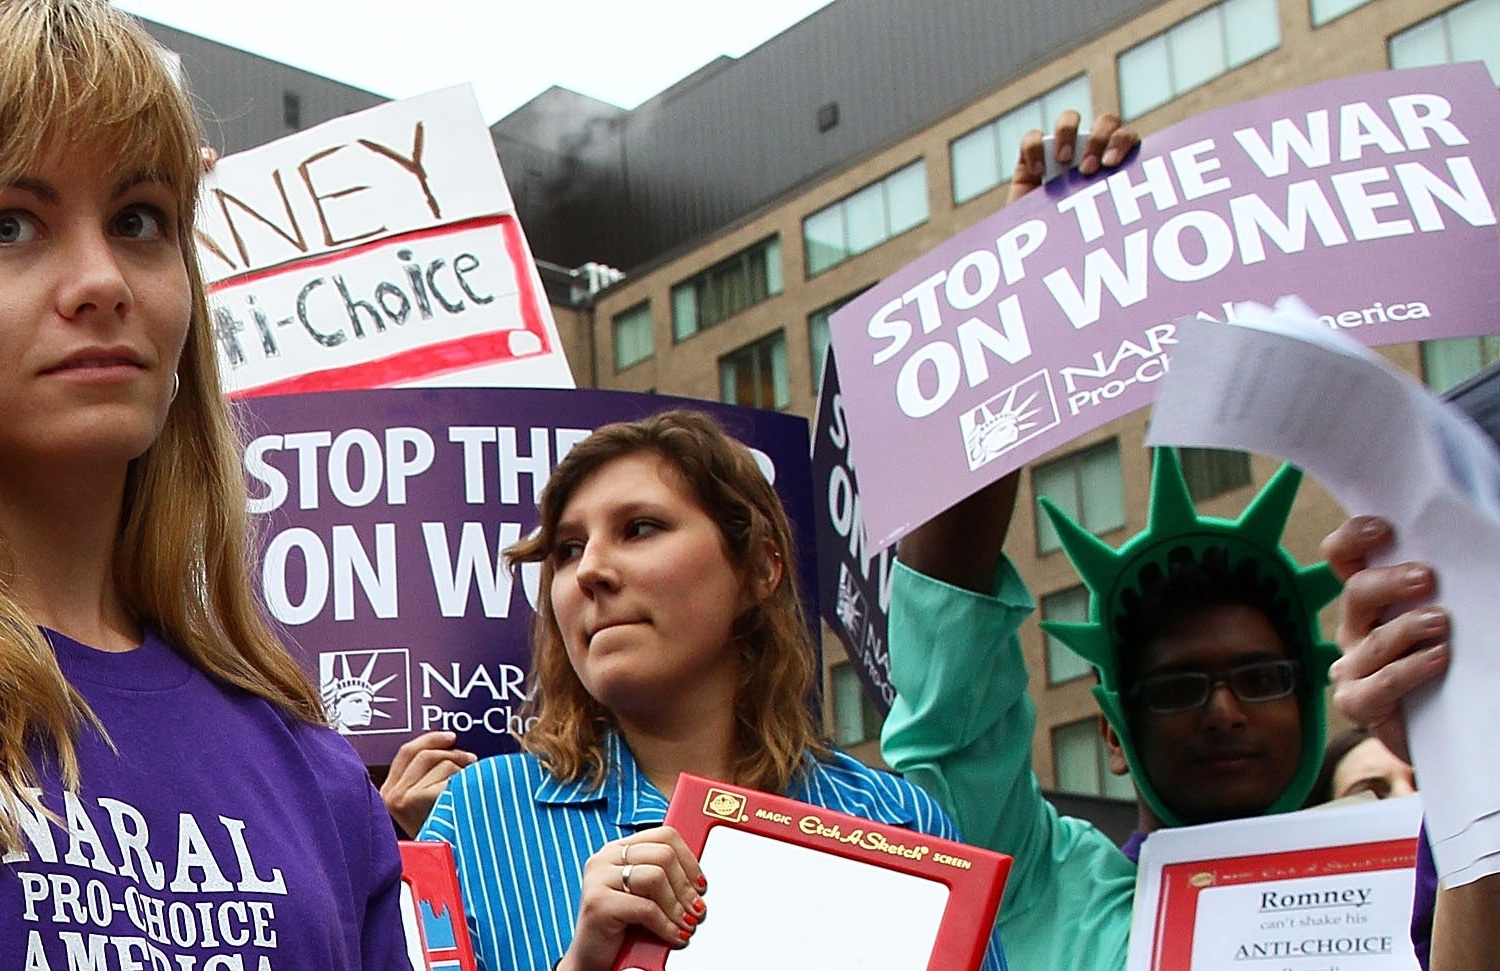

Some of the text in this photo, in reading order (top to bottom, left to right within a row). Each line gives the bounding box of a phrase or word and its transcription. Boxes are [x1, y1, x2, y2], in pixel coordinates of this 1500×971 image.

[865, 93, 1470, 365] STOP THE WAR
[895, 294, 1033, 418] ON
[1042, 156, 1497, 330] WOMEN
[243, 427, 435, 515] STOP
[262, 522, 399, 625] ON
[755, 809, 792, 825] MAGIC
[799, 815, 841, 840] Etch
[840, 829, 861, 846] A
[932, 853, 971, 870] SCREEN
[17, 871, 278, 949] PRO-CHOICE
[1260, 888, 1372, 910] Romney
[1260, 912, 1368, 930] can't shake his
[1234, 936, 1393, 960] ANTI-CHOICE
